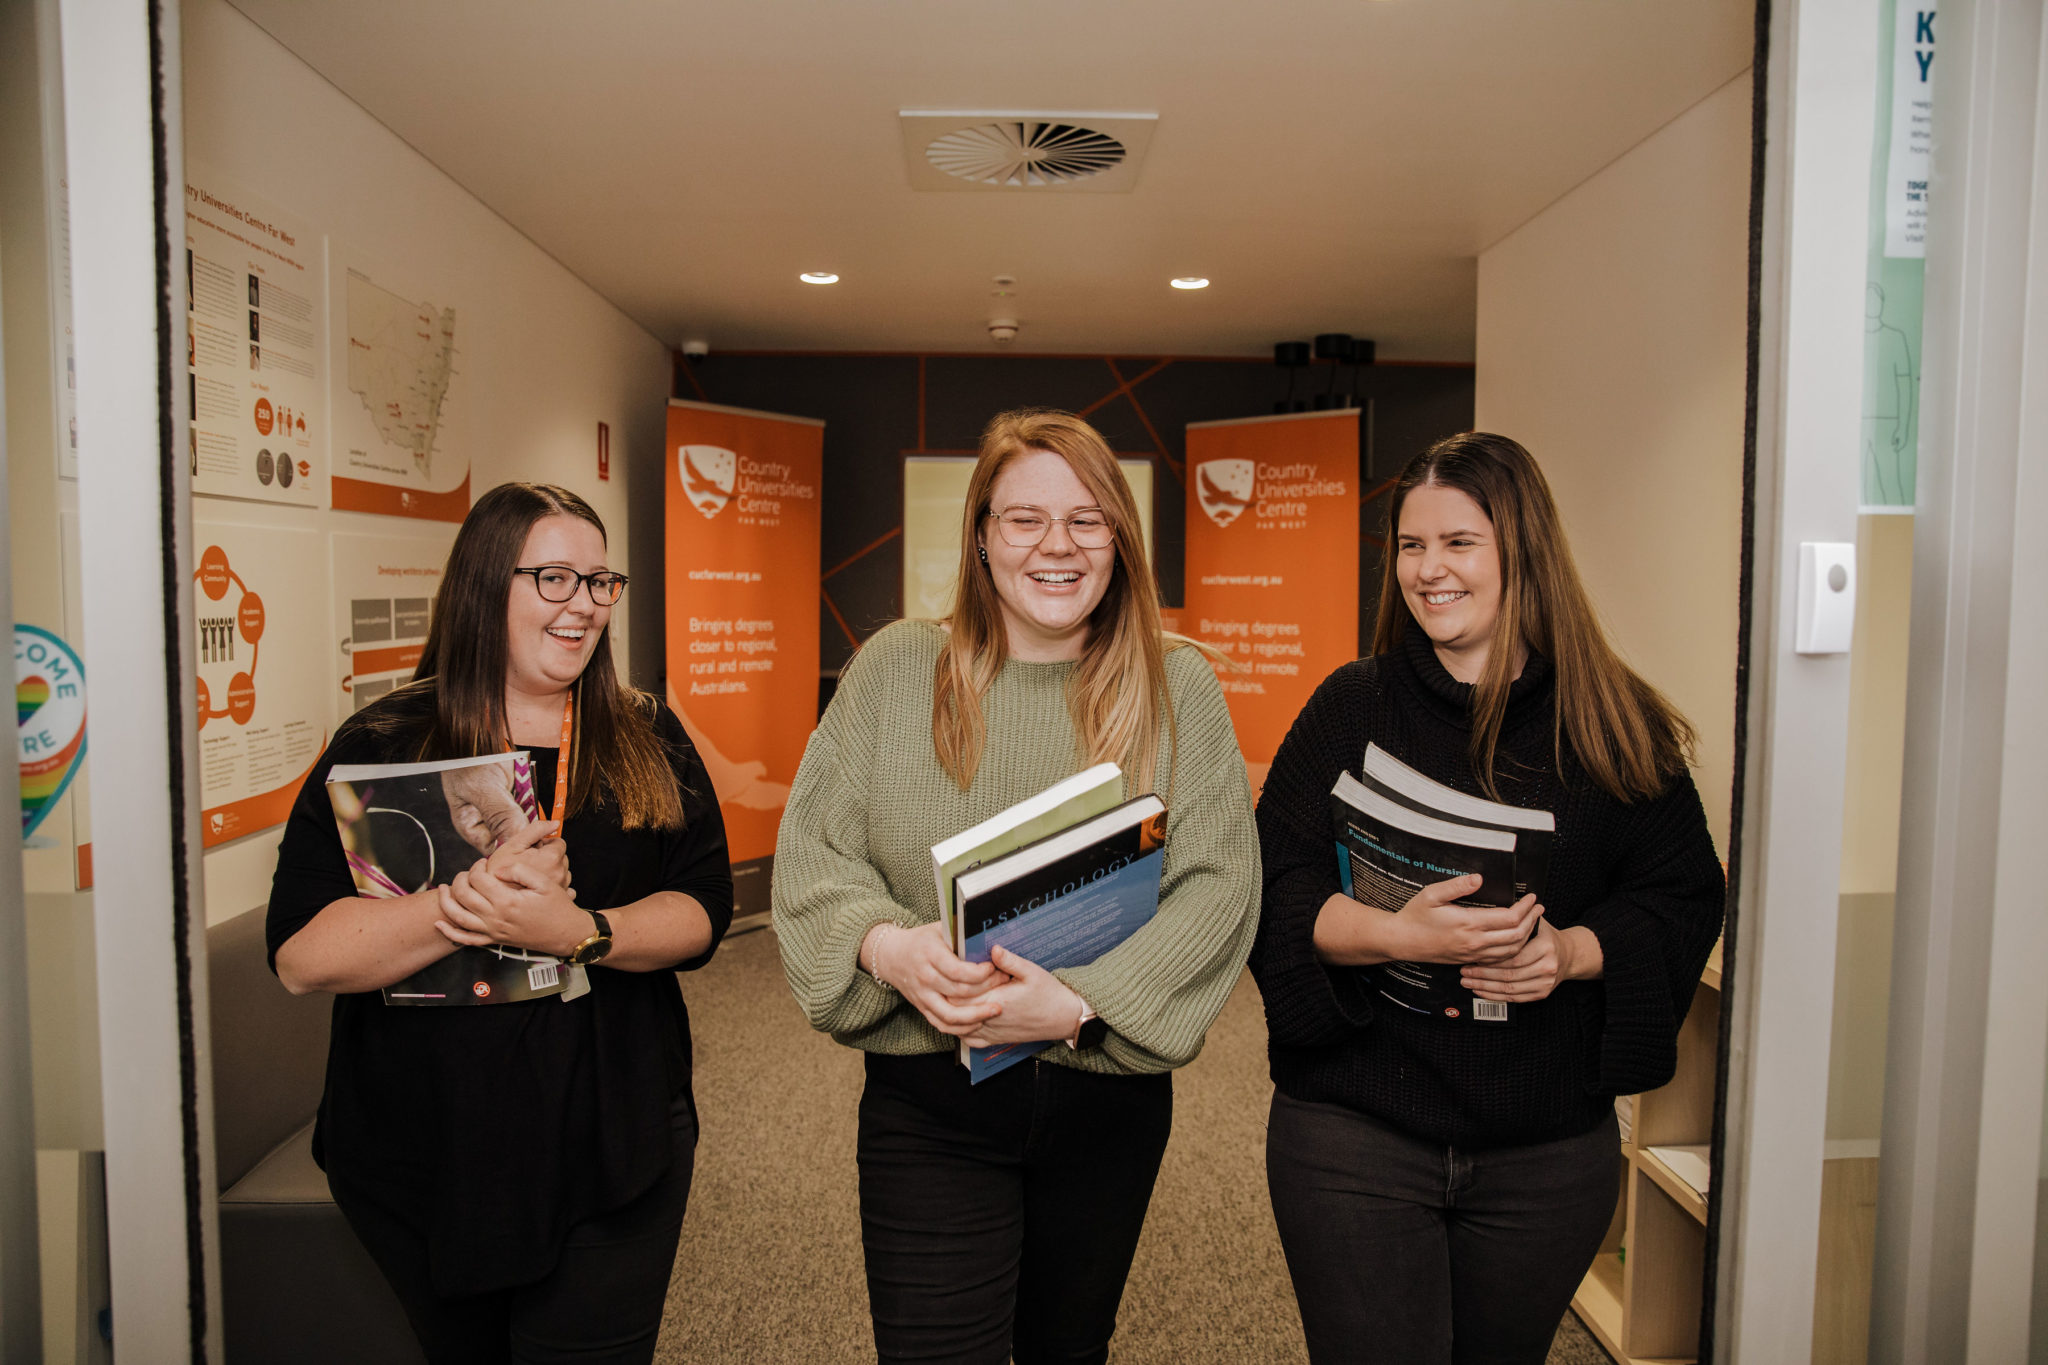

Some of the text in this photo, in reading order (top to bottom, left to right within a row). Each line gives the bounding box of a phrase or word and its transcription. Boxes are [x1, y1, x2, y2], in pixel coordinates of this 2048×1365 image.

[200, 189, 243, 221] Universities
[244, 211, 266, 232] Centre
[738, 455, 790, 481] Country
[1256, 462, 1317, 482] Country
[738, 475, 814, 499] Universities
[1256, 478, 1346, 499] Universities
[737, 494, 781, 515] Centre
[1256, 500, 1307, 517] Centre
[1256, 520, 1306, 530] FAR WEST
[689, 617, 774, 636] Bringing degrees
[1200, 618, 1249, 637] Bringing
[1251, 621, 1300, 638] degrees
[689, 638, 778, 655] closer to regional,
[1238, 642, 1251, 654] to
[1253, 641, 1306, 658] regional,
[689, 659, 773, 675] rural and remote
[1255, 661, 1300, 676] remote
[689, 678, 749, 696] Australians.
[1348, 827, 1411, 865] Fundamentals
[1413, 861, 1424, 869] of
[982, 853, 1136, 932] PSYCHOLOGY
